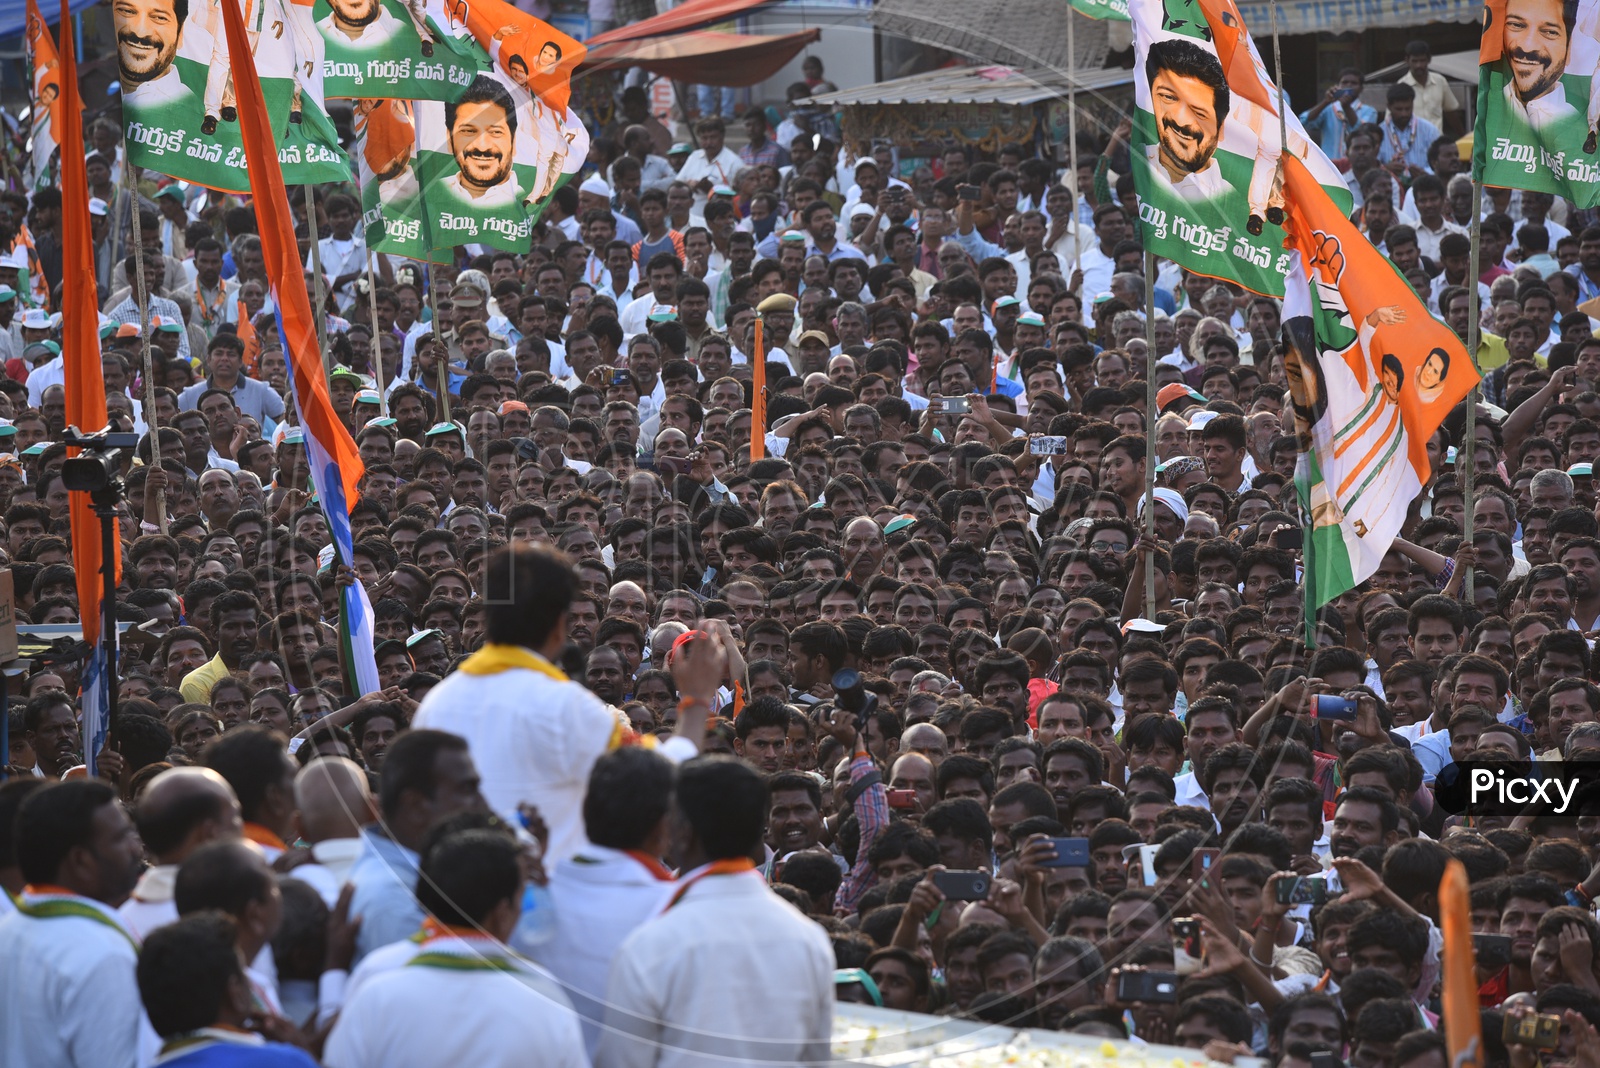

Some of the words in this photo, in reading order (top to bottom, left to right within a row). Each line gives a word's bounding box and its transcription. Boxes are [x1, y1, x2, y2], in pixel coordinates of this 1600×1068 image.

[1294, 2, 1384, 27] TIFFIN
[415, 61, 445, 82] మన
[448, 65, 472, 88] ఓటు
[186, 138, 223, 164] మన
[305, 144, 342, 164] ఓటు
[1233, 237, 1271, 269] మన
